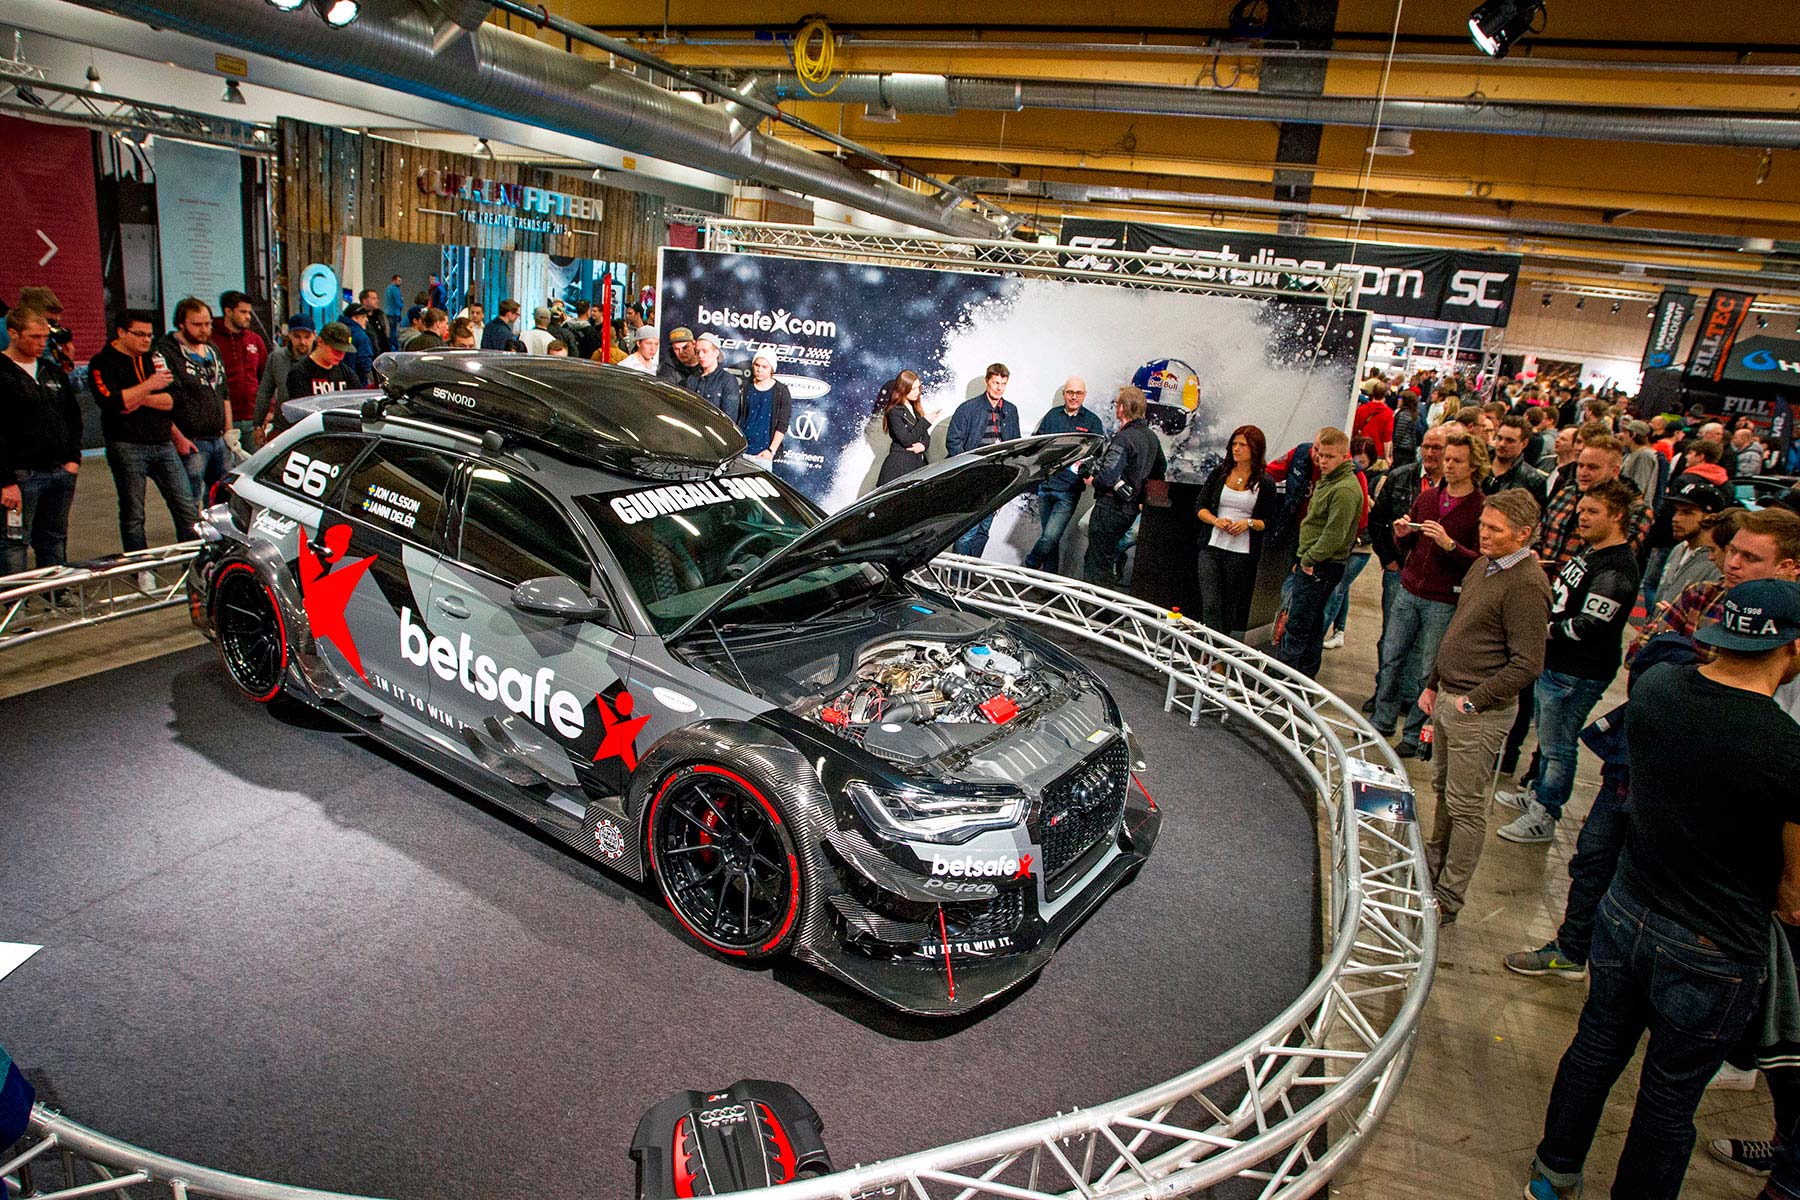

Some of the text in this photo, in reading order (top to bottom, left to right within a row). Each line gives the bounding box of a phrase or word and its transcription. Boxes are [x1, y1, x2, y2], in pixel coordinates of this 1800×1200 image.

[461, 209, 476, 223] THE
[479, 211, 513, 228] CREATIVE
[514, 216, 541, 232] TRENDS
[1446, 270, 1510, 308] SC
[1664, 303, 1685, 350] ACADEMY
[1690, 296, 1736, 377] FILLTEC
[776, 355, 831, 368] otorsport
[1149, 379, 1179, 391] Red Bull
[373, 485, 421, 513] JON OLSSON
[609, 476, 781, 525] GUMBALL 3000
[367, 501, 417, 530] JANNI DELÉR
[1586, 597, 1618, 618] CBJ
[1743, 606, 1763, 615] 1998
[400, 605, 585, 739] betsafe
[374, 674, 390, 692] IN
[392, 683, 406, 701] IT
[408, 692, 424, 711] TO
[427, 703, 454, 728] WIN
[931, 853, 1017, 877] betsafe
[922, 944, 937, 956] IN
[940, 943, 953, 955] IT
[955, 943, 970, 952] TO
[972, 939, 997, 951] WIN
